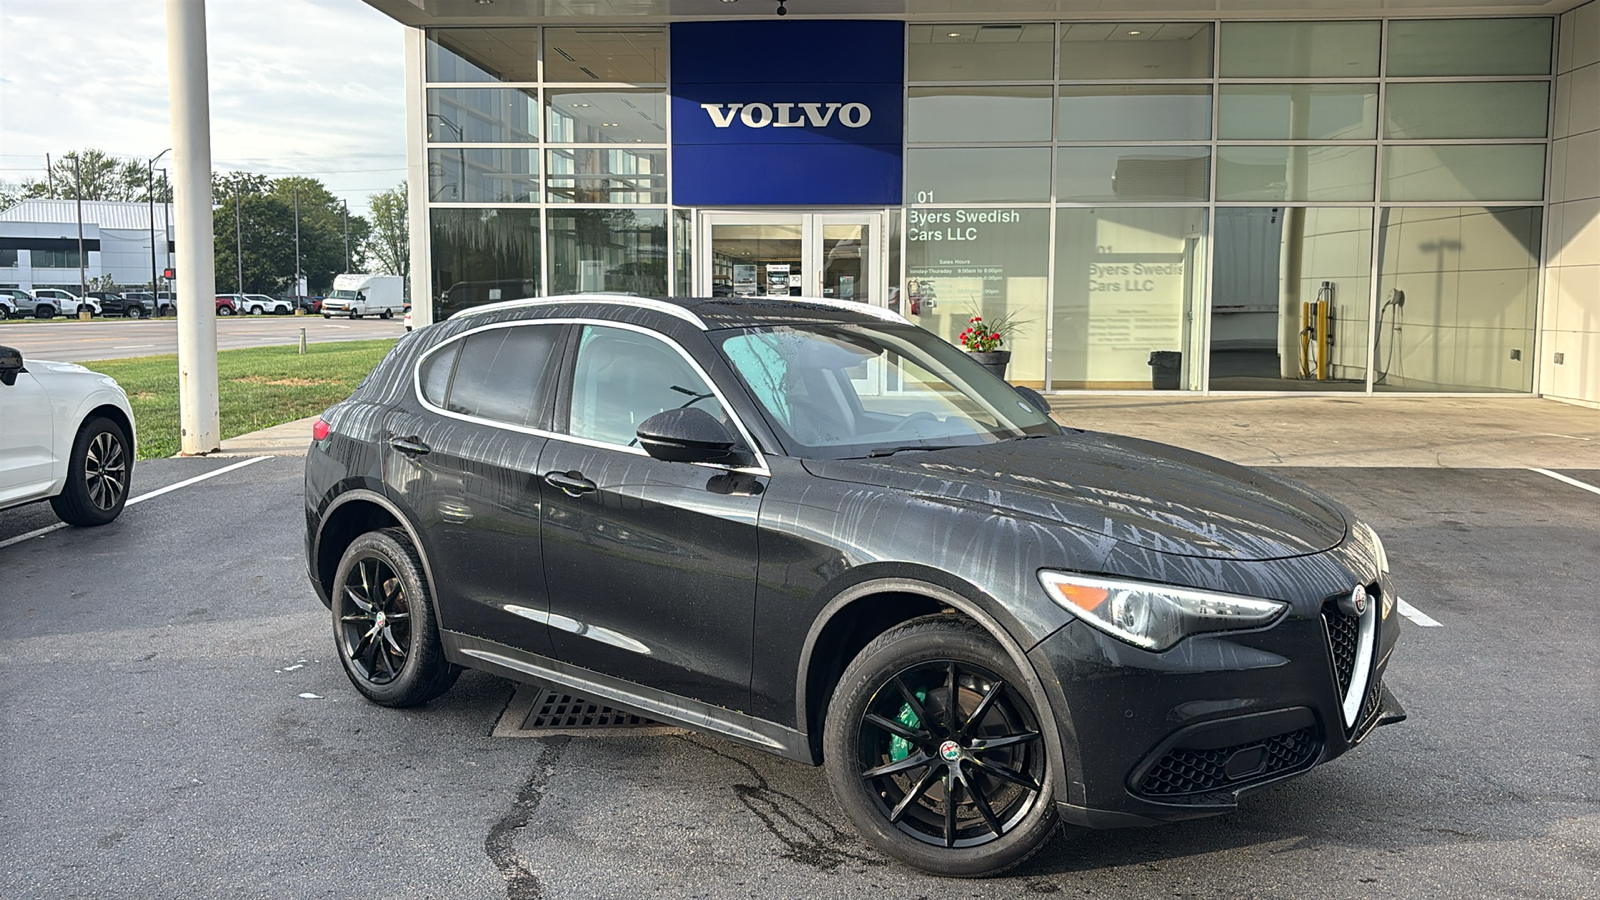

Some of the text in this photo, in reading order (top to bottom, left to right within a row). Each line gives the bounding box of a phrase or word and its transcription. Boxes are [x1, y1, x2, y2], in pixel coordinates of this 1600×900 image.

[700, 102, 872, 128] VOLVO
[909, 191, 934, 203] 01
[909, 209, 1020, 226] Byers Swedish
[909, 227, 978, 241] Cars LLC
[1133, 263, 1183, 275] Swedis
[1125, 279, 1155, 292] LLC
